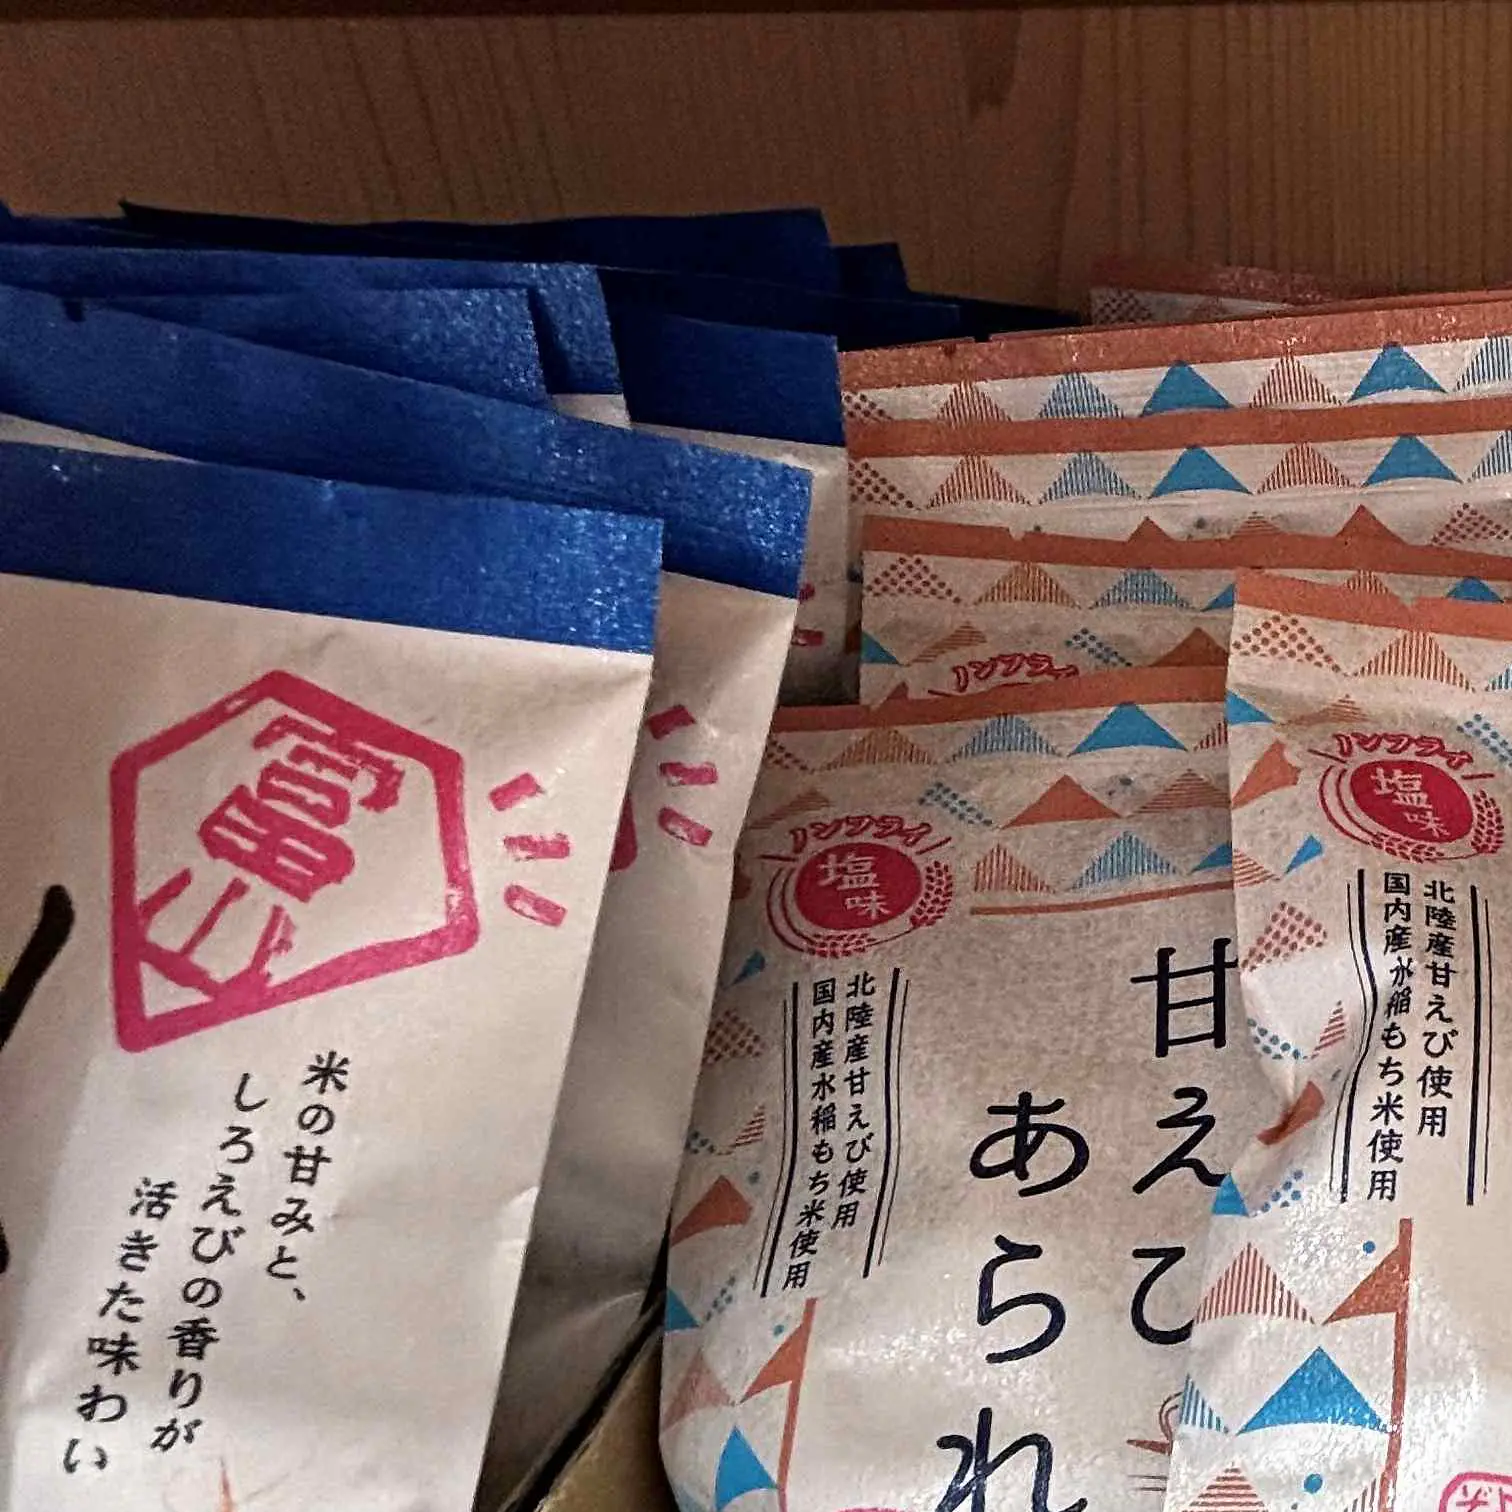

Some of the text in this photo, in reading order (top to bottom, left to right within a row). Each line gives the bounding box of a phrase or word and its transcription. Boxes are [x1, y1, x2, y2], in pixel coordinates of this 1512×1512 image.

[789, 815, 932, 854] ノンフライ
[1333, 732, 1473, 770] ノンフライ
[1370, 766, 1451, 838] 塩味
[817, 853, 892, 920] 塩味
[1417, 880, 1460, 1138] 北陸産甘えび使用
[782, 977, 838, 1291] 国内産水稲もち米使用
[831, 971, 875, 1231] 北陸産甘えび使用
[1367, 872, 1414, 1202] 国内産水稲もち米使用
[151, 1071, 271, 1453] しろえびの香りが
[266, 1050, 350, 1303] 米の甘みと、
[62, 1177, 180, 1474] 活きた味わい
